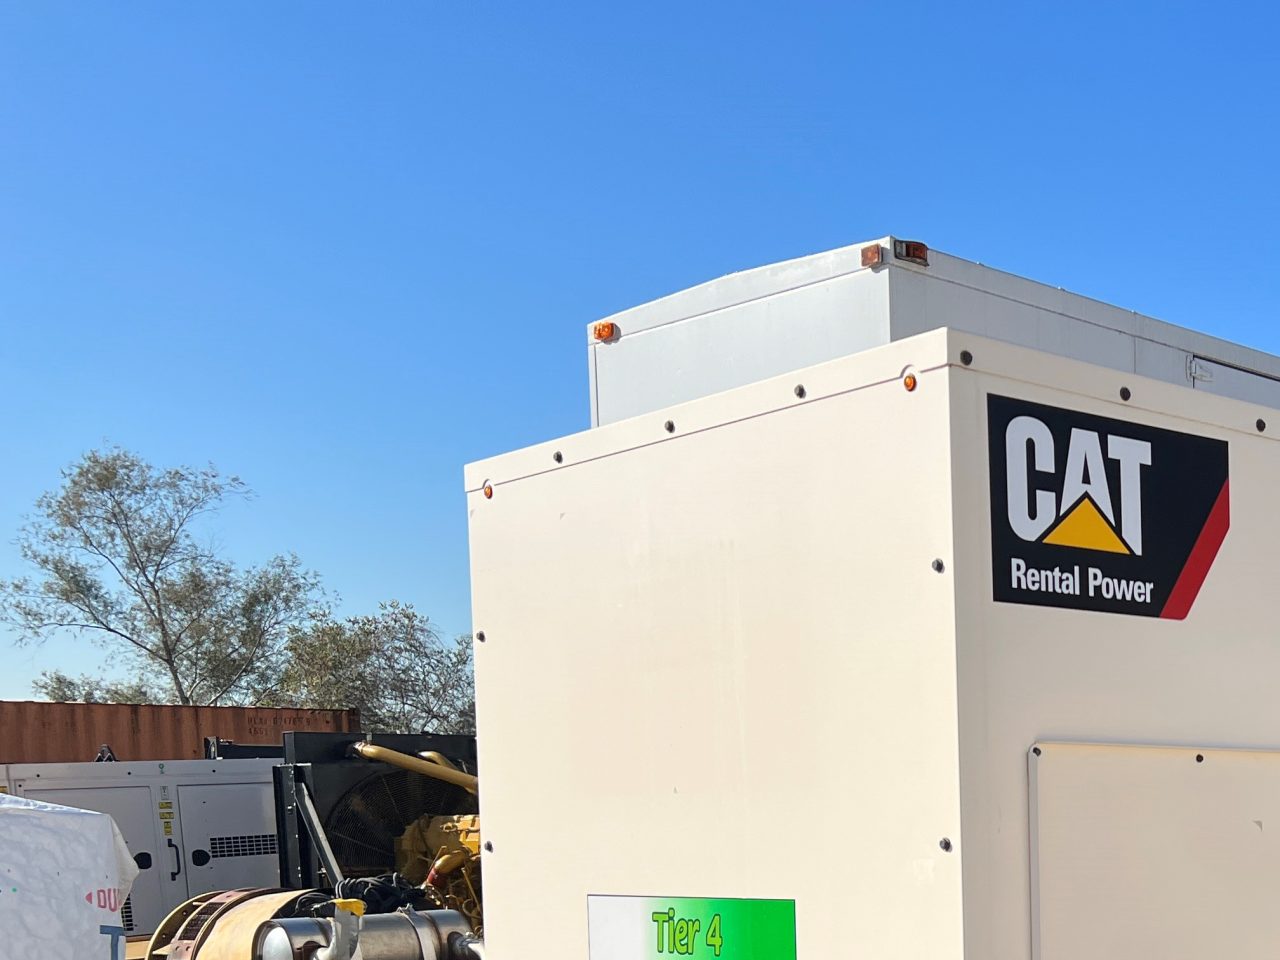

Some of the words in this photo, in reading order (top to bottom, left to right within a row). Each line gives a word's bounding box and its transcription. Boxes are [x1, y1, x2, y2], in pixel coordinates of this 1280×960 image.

[1006, 416, 1152, 556] CAT
[1011, 558, 1080, 595] Rental
[1088, 567, 1154, 603] Power
[652, 908, 700, 955] Tier
[706, 914, 723, 956] 4
